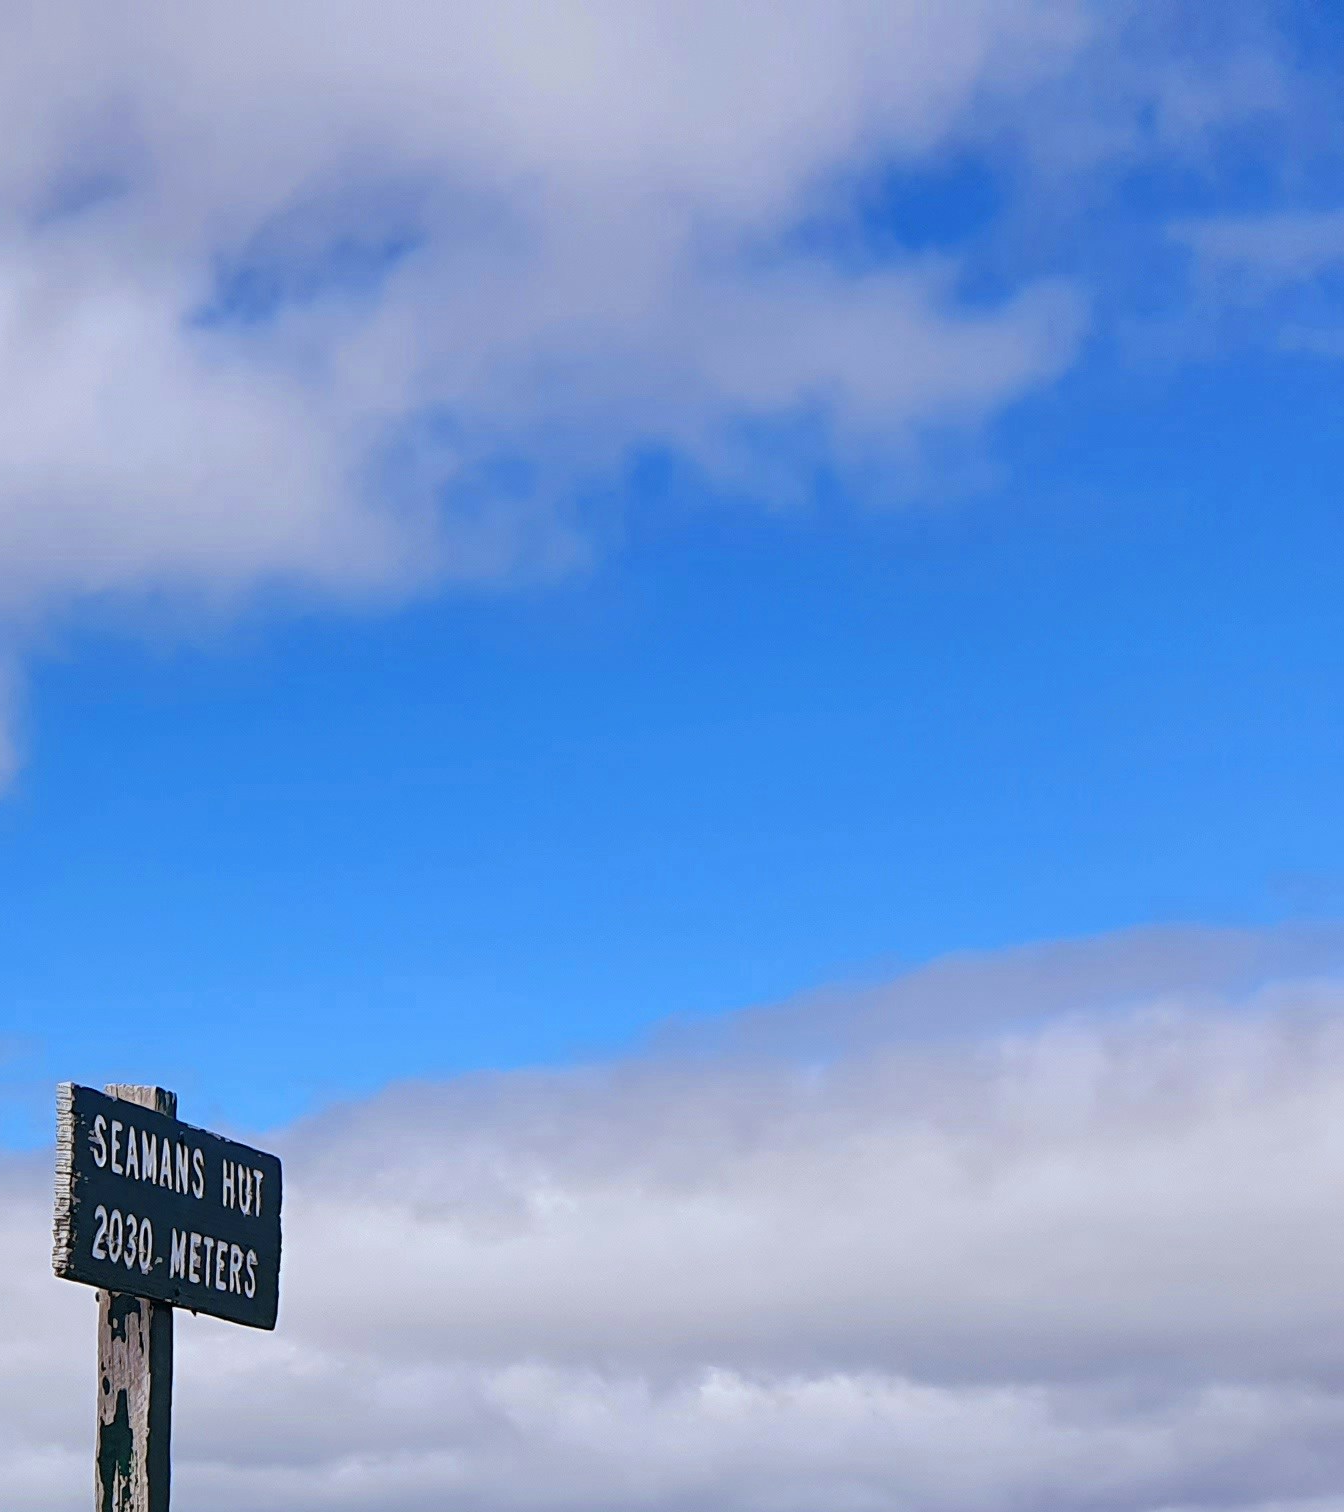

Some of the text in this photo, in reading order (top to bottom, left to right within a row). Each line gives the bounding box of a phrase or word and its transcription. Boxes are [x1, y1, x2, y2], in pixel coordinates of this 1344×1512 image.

[90, 1114, 264, 1217] SEAMANS HUT
[91, 1204, 259, 1298] 2030 METERS
